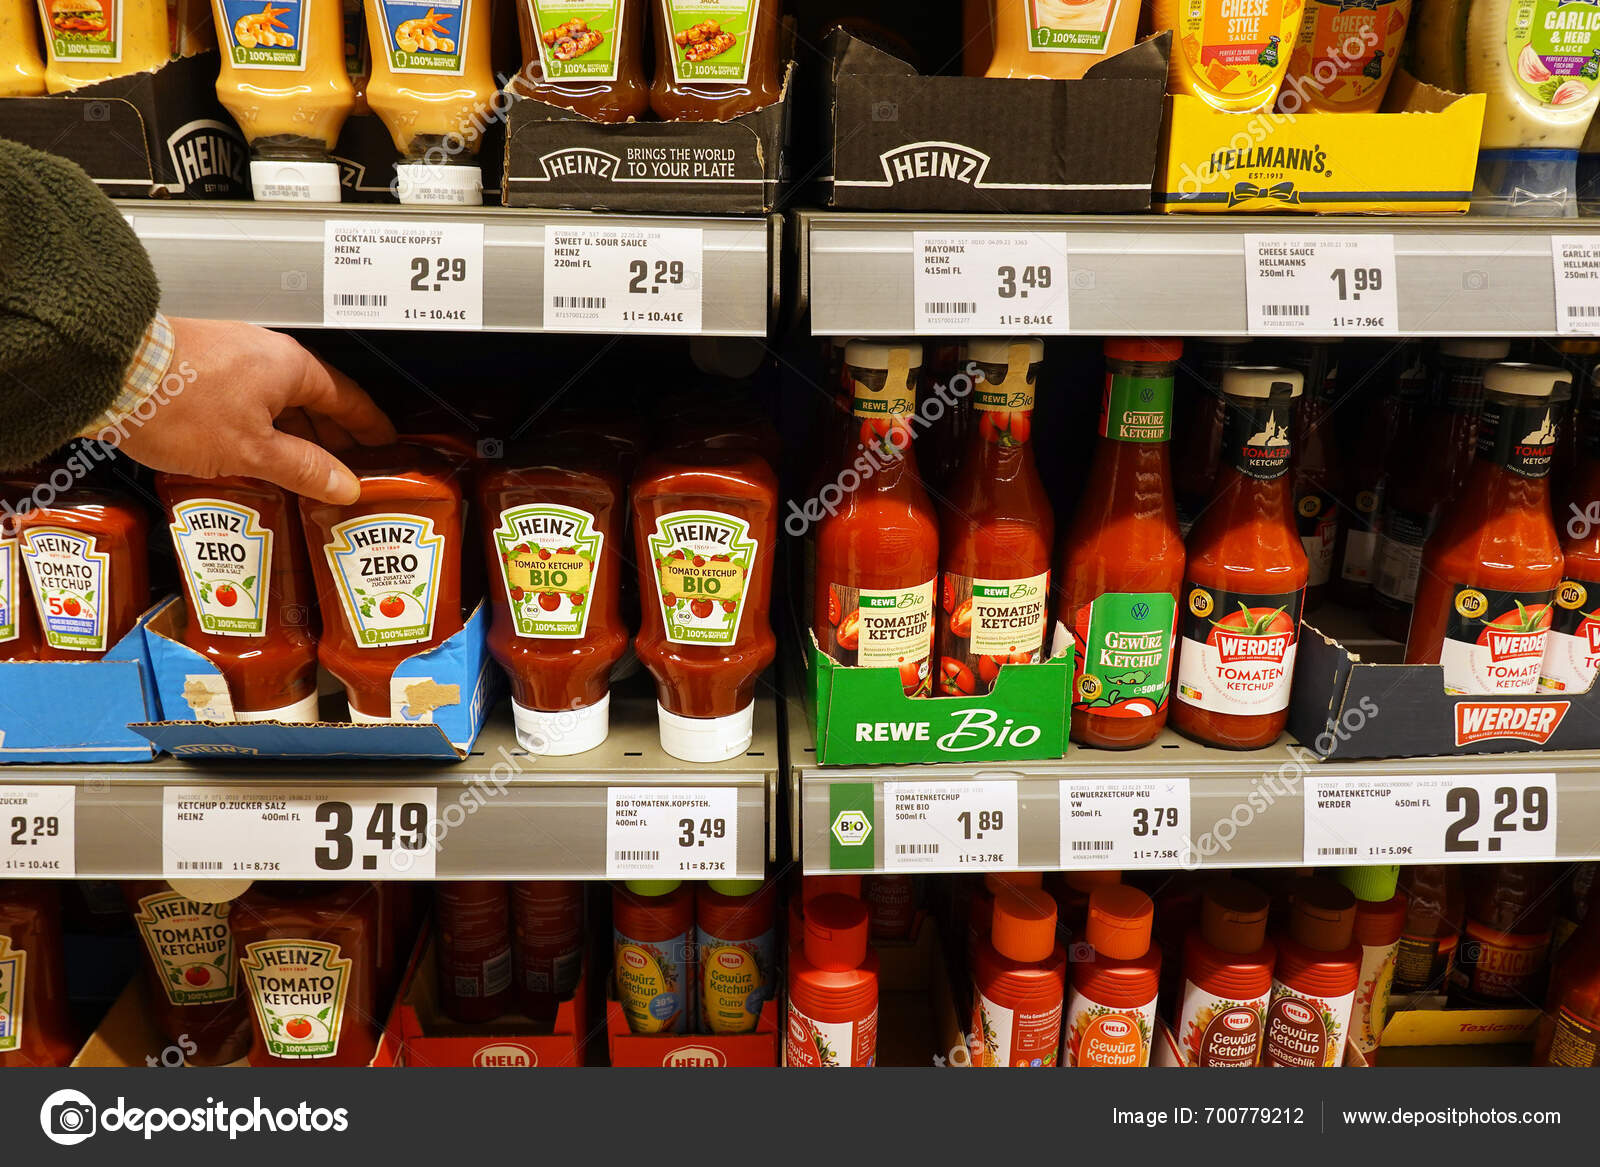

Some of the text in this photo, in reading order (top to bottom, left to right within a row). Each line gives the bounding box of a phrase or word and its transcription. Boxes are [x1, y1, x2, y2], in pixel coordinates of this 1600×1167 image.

[1228, 18, 1260, 33] STYLE
[1544, 11, 1600, 31] GARLIC
[1052, 33, 1077, 44] 100%
[1550, 31, 1591, 44] & HERB
[1554, 45, 1583, 53] SAUCE
[410, 56, 434, 66] 100%
[695, 65, 718, 74] 100%
[627, 148, 736, 161] BRINGS THE WORLD
[549, 156, 611, 179] HEINZ
[628, 163, 736, 177] TO YOUR PLATE
[892, 152, 976, 184] HEINZ
[334, 234, 442, 245] COCKTAIL SAUCE KOPFST
[554, 238, 648, 248] SWEET U. SOUR SAUCE
[334, 246, 360, 254] HEINZ
[554, 248, 580, 257] HEINZ
[924, 246, 964, 254] MAYOMIX
[334, 257, 361, 265] 220ml
[1259, 258, 1306, 266] HELLMANNS
[410, 257, 466, 292] 2.29
[629, 260, 684, 294] 2.29
[925, 266, 951, 275] 415ml
[1260, 269, 1284, 277] 250ml
[998, 266, 1052, 298] 3.49
[1330, 268, 1382, 301] 1.99
[430, 310, 466, 320] 10.41€
[648, 312, 684, 322] 10.41€
[1356, 318, 1384, 327] 7.96€
[862, 399, 914, 414] REWE Bio
[188, 513, 240, 532] HEINZ
[518, 518, 576, 538] HEINZ
[353, 528, 415, 548] HEINZ
[674, 525, 730, 545] HEINZ
[36, 538, 80, 556] HEINZ
[196, 542, 246, 562] ZERO
[35, 561, 92, 578] TOMATO
[360, 554, 418, 576] ZERO
[514, 560, 584, 570] TOMATO KETCHUP
[668, 566, 738, 577] TOMATO KETCHUP
[40, 577, 92, 590] KETCHUP
[530, 570, 568, 587] BIO
[683, 577, 721, 594] BIO
[984, 584, 1038, 599] REWE Bio
[870, 593, 924, 608] REWE Bio
[977, 602, 1042, 618] TOMATEN-
[864, 610, 930, 628] TOMATEN-
[982, 614, 1040, 629] KETCHUP
[686, 630, 708, 638] 100%
[868, 622, 928, 640] KETCHUP
[1105, 632, 1162, 650] GEWÜRZ
[1221, 636, 1285, 656] WERDER
[1099, 649, 1162, 668] KETCHUP
[1216, 666, 1284, 680] TOMATEN
[1486, 662, 1540, 678] TOMATE
[1226, 682, 1274, 691] KETCHUP
[1463, 708, 1556, 734] WERDER
[856, 708, 1041, 752] REWE Bio
[1318, 789, 1392, 798] TOMATENKETCHUP
[178, 802, 286, 810] KETCHUP O.ZUCKER SALZ
[1318, 800, 1431, 809] WERDER 450ml FL
[178, 813, 300, 821] HEINZ 400ml FL
[1133, 808, 1178, 836] 3.79
[1444, 786, 1548, 852] 2.29
[11, 816, 58, 845] 2.29
[678, 818, 726, 847] 3.49
[957, 810, 1004, 840] 1.89
[314, 802, 428, 870] 3.49
[1154, 850, 1178, 858] 7.58€
[1388, 846, 1413, 856] 5.09€
[254, 862, 280, 870] 8.73€
[155, 902, 213, 920] HEINZ
[152, 924, 227, 944] TOMATO
[160, 940, 226, 956] KETCHUP
[262, 950, 323, 967] HEINZ
[257, 976, 334, 992] TOMATO
[711, 970, 752, 984] Gewürz
[710, 980, 754, 994] Ketchup
[264, 992, 332, 1006] KETCHUP
[1230, 1016, 1250, 1026] HELA
[1286, 1008, 1308, 1020] HELA
[1273, 1018, 1320, 1042] Gewürz
[1090, 1039, 1136, 1054] Gewürz
[1212, 1032, 1256, 1047] Gewürz
[1269, 1029, 1320, 1054] Ketchup
[1087, 1049, 1136, 1066] Ketchup
[1208, 1043, 1256, 1058] Ketchup
[1268, 1044, 1316, 1067] Schaschlik
[485, 1055, 525, 1067] HELA
